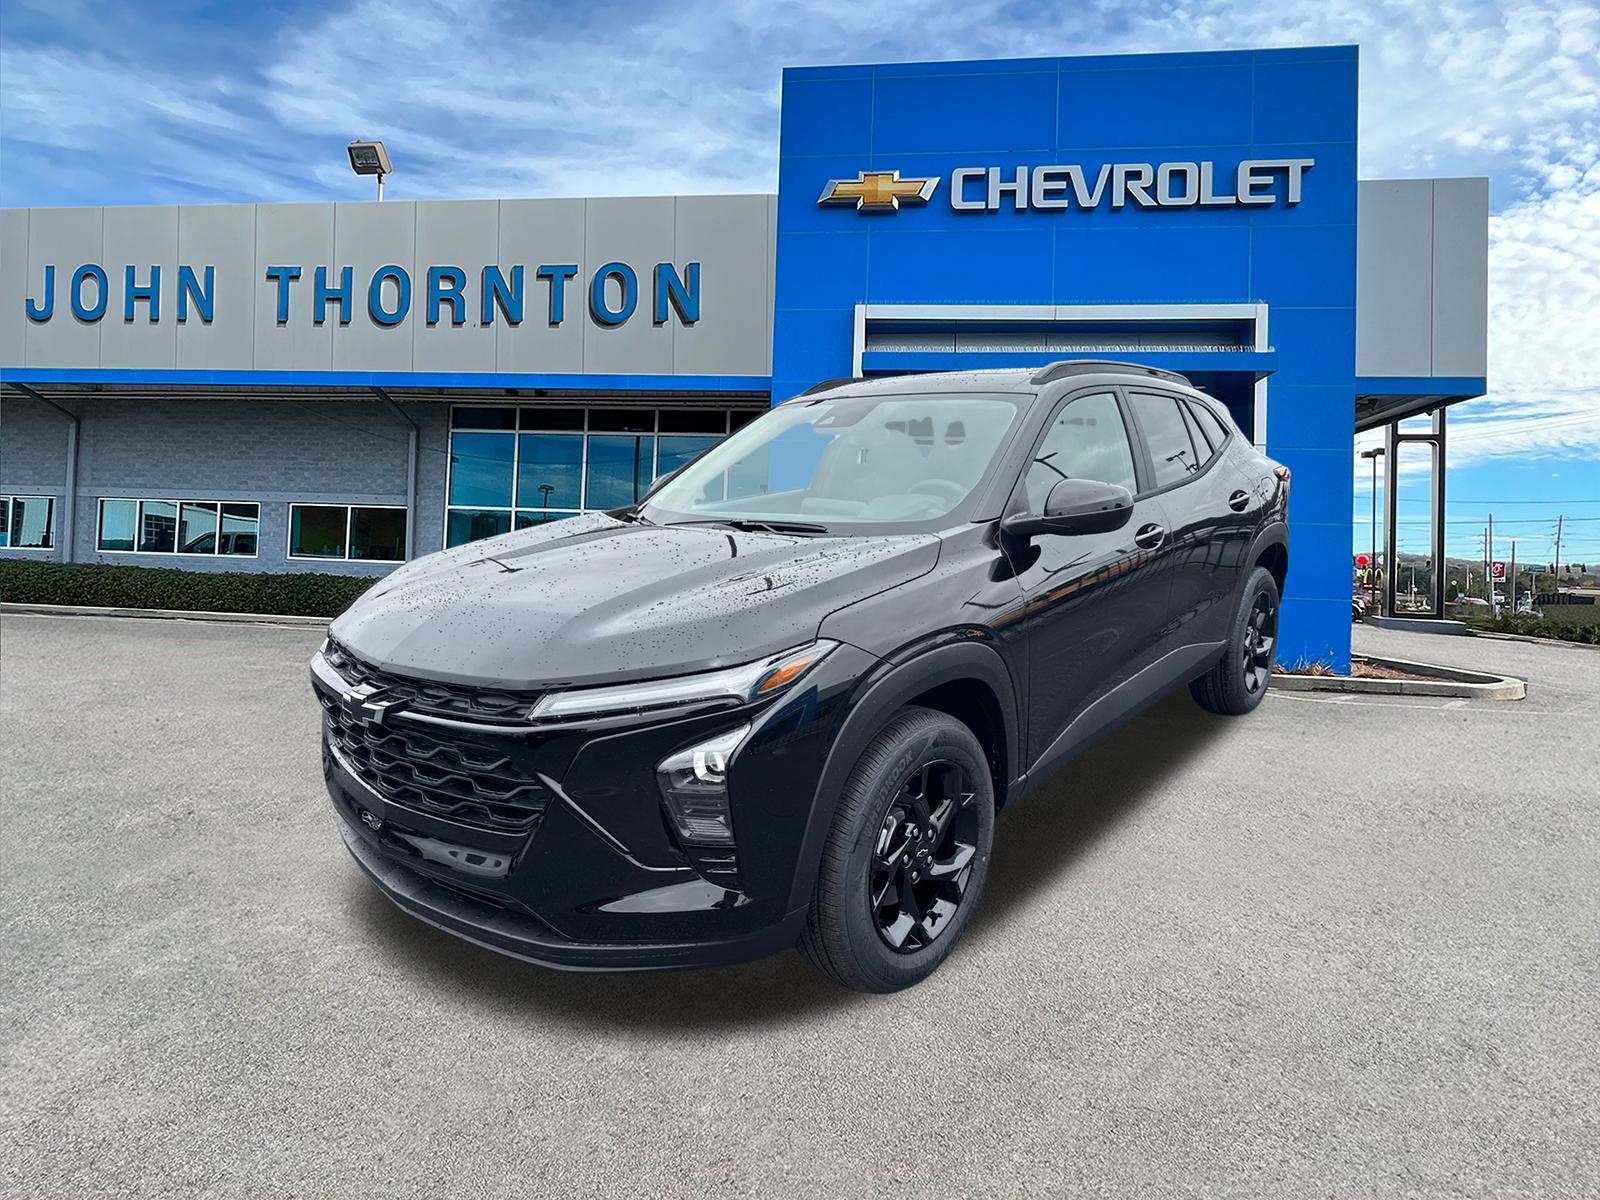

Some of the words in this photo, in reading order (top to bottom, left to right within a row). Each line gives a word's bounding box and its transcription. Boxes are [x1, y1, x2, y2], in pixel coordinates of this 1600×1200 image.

[951, 158, 1315, 210] CHEVROLET
[25, 264, 215, 323] JOHN
[265, 262, 701, 327] THORNTON
